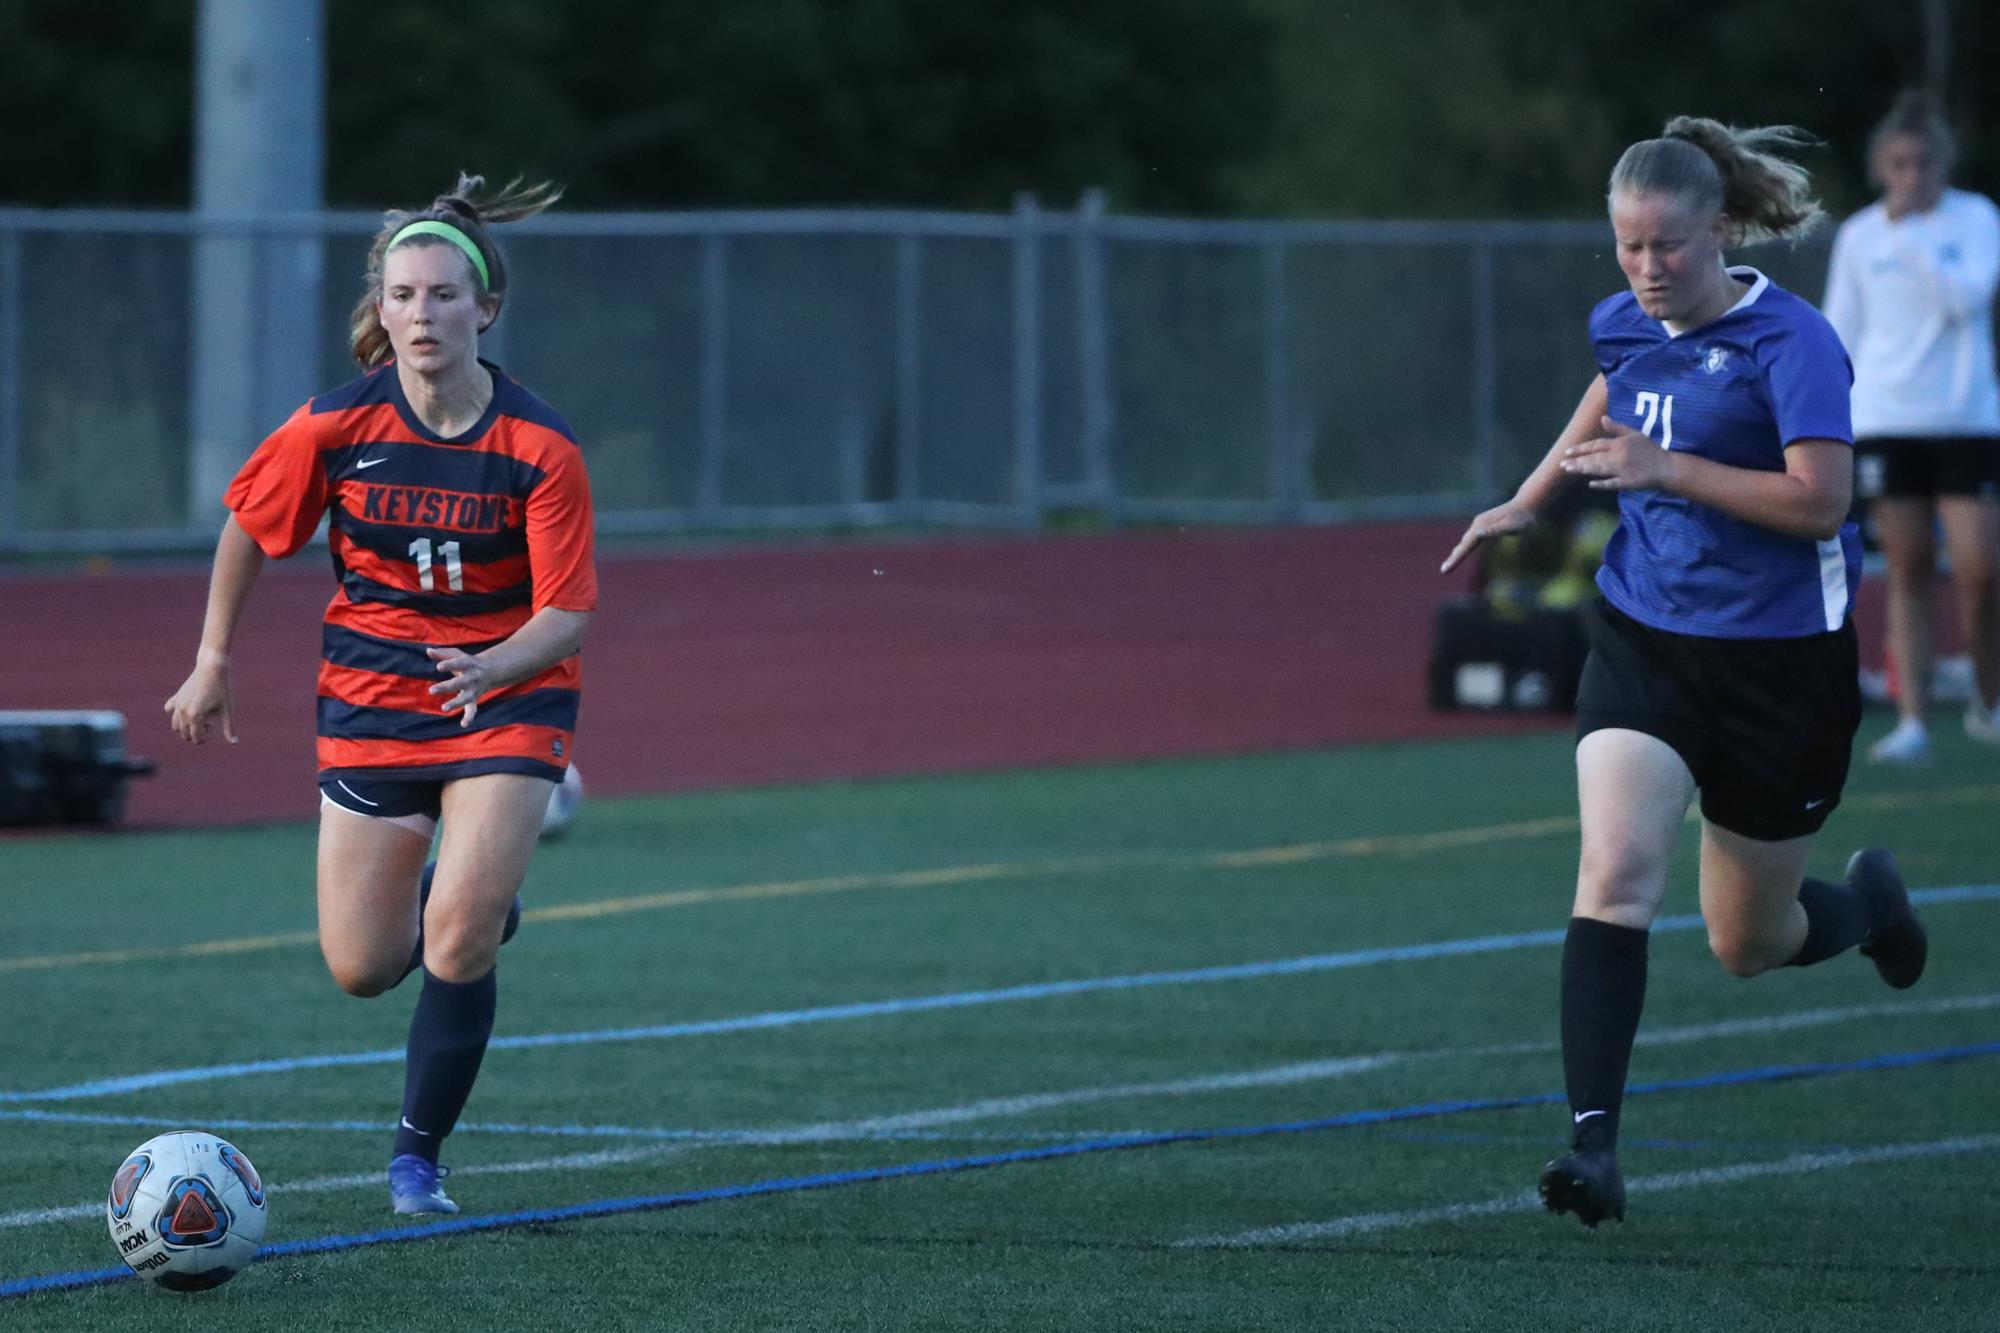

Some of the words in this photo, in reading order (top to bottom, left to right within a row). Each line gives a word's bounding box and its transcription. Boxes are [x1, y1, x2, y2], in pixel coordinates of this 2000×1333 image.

[409, 537, 463, 591] 11
[120, 1229, 149, 1252] NCAA
[132, 1251, 171, 1273] Wilson
